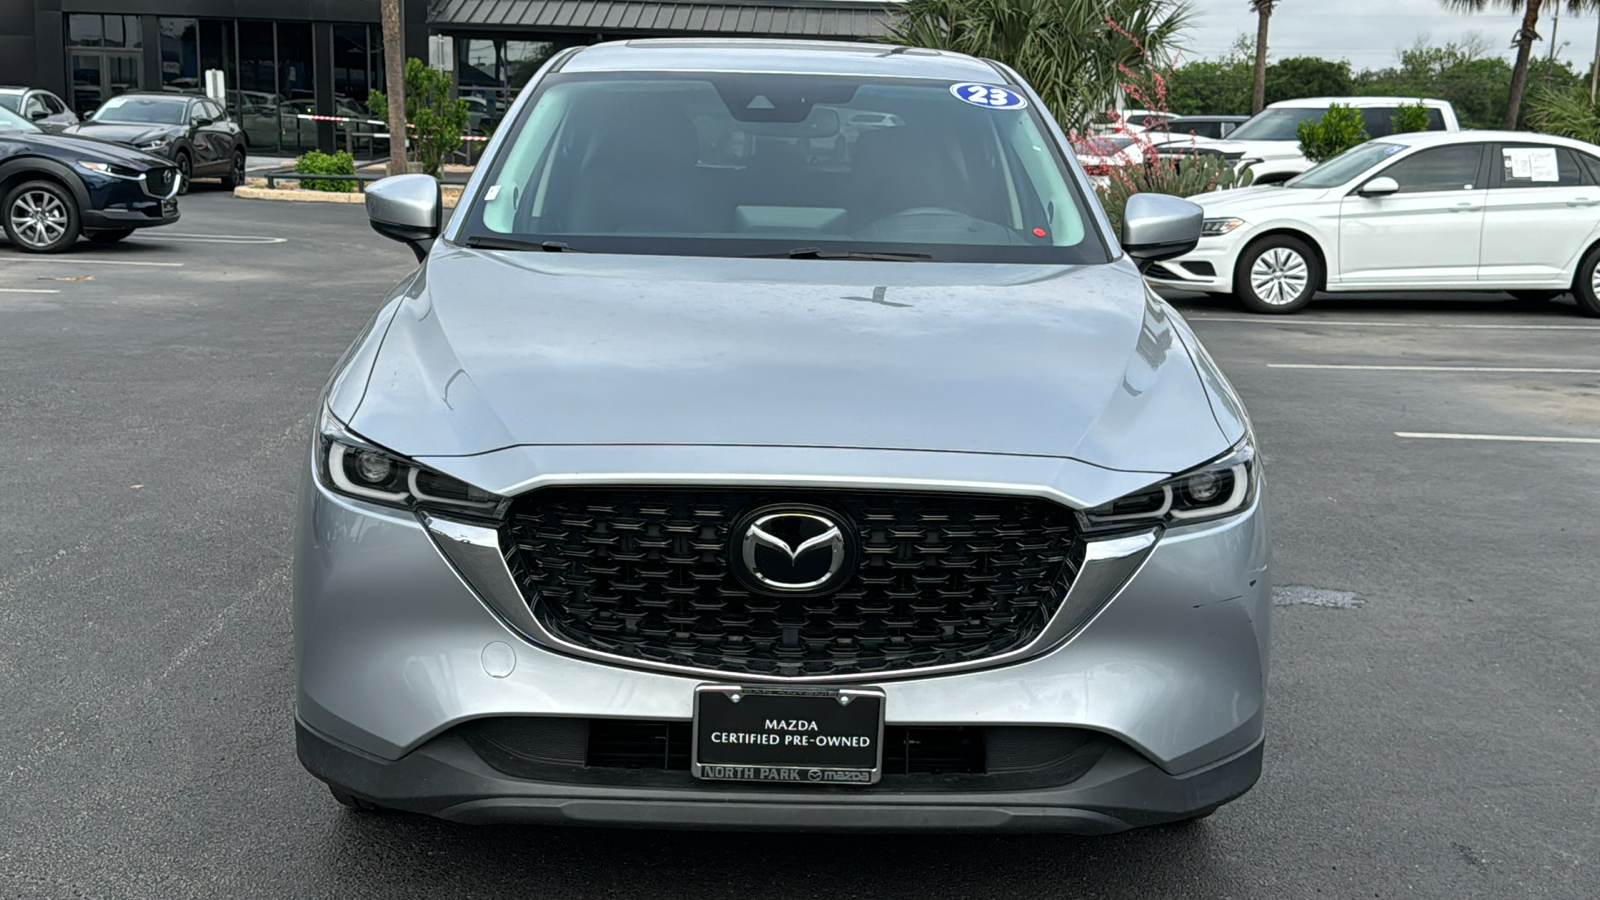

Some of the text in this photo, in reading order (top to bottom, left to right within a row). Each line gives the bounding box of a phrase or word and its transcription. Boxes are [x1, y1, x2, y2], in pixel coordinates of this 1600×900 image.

[968, 86, 1008, 105] 23
[765, 719, 818, 731] MAZDA
[711, 732, 870, 747] CERTIFIED PRE-OWNED
[704, 766, 869, 781] NORTH PARK mazda
